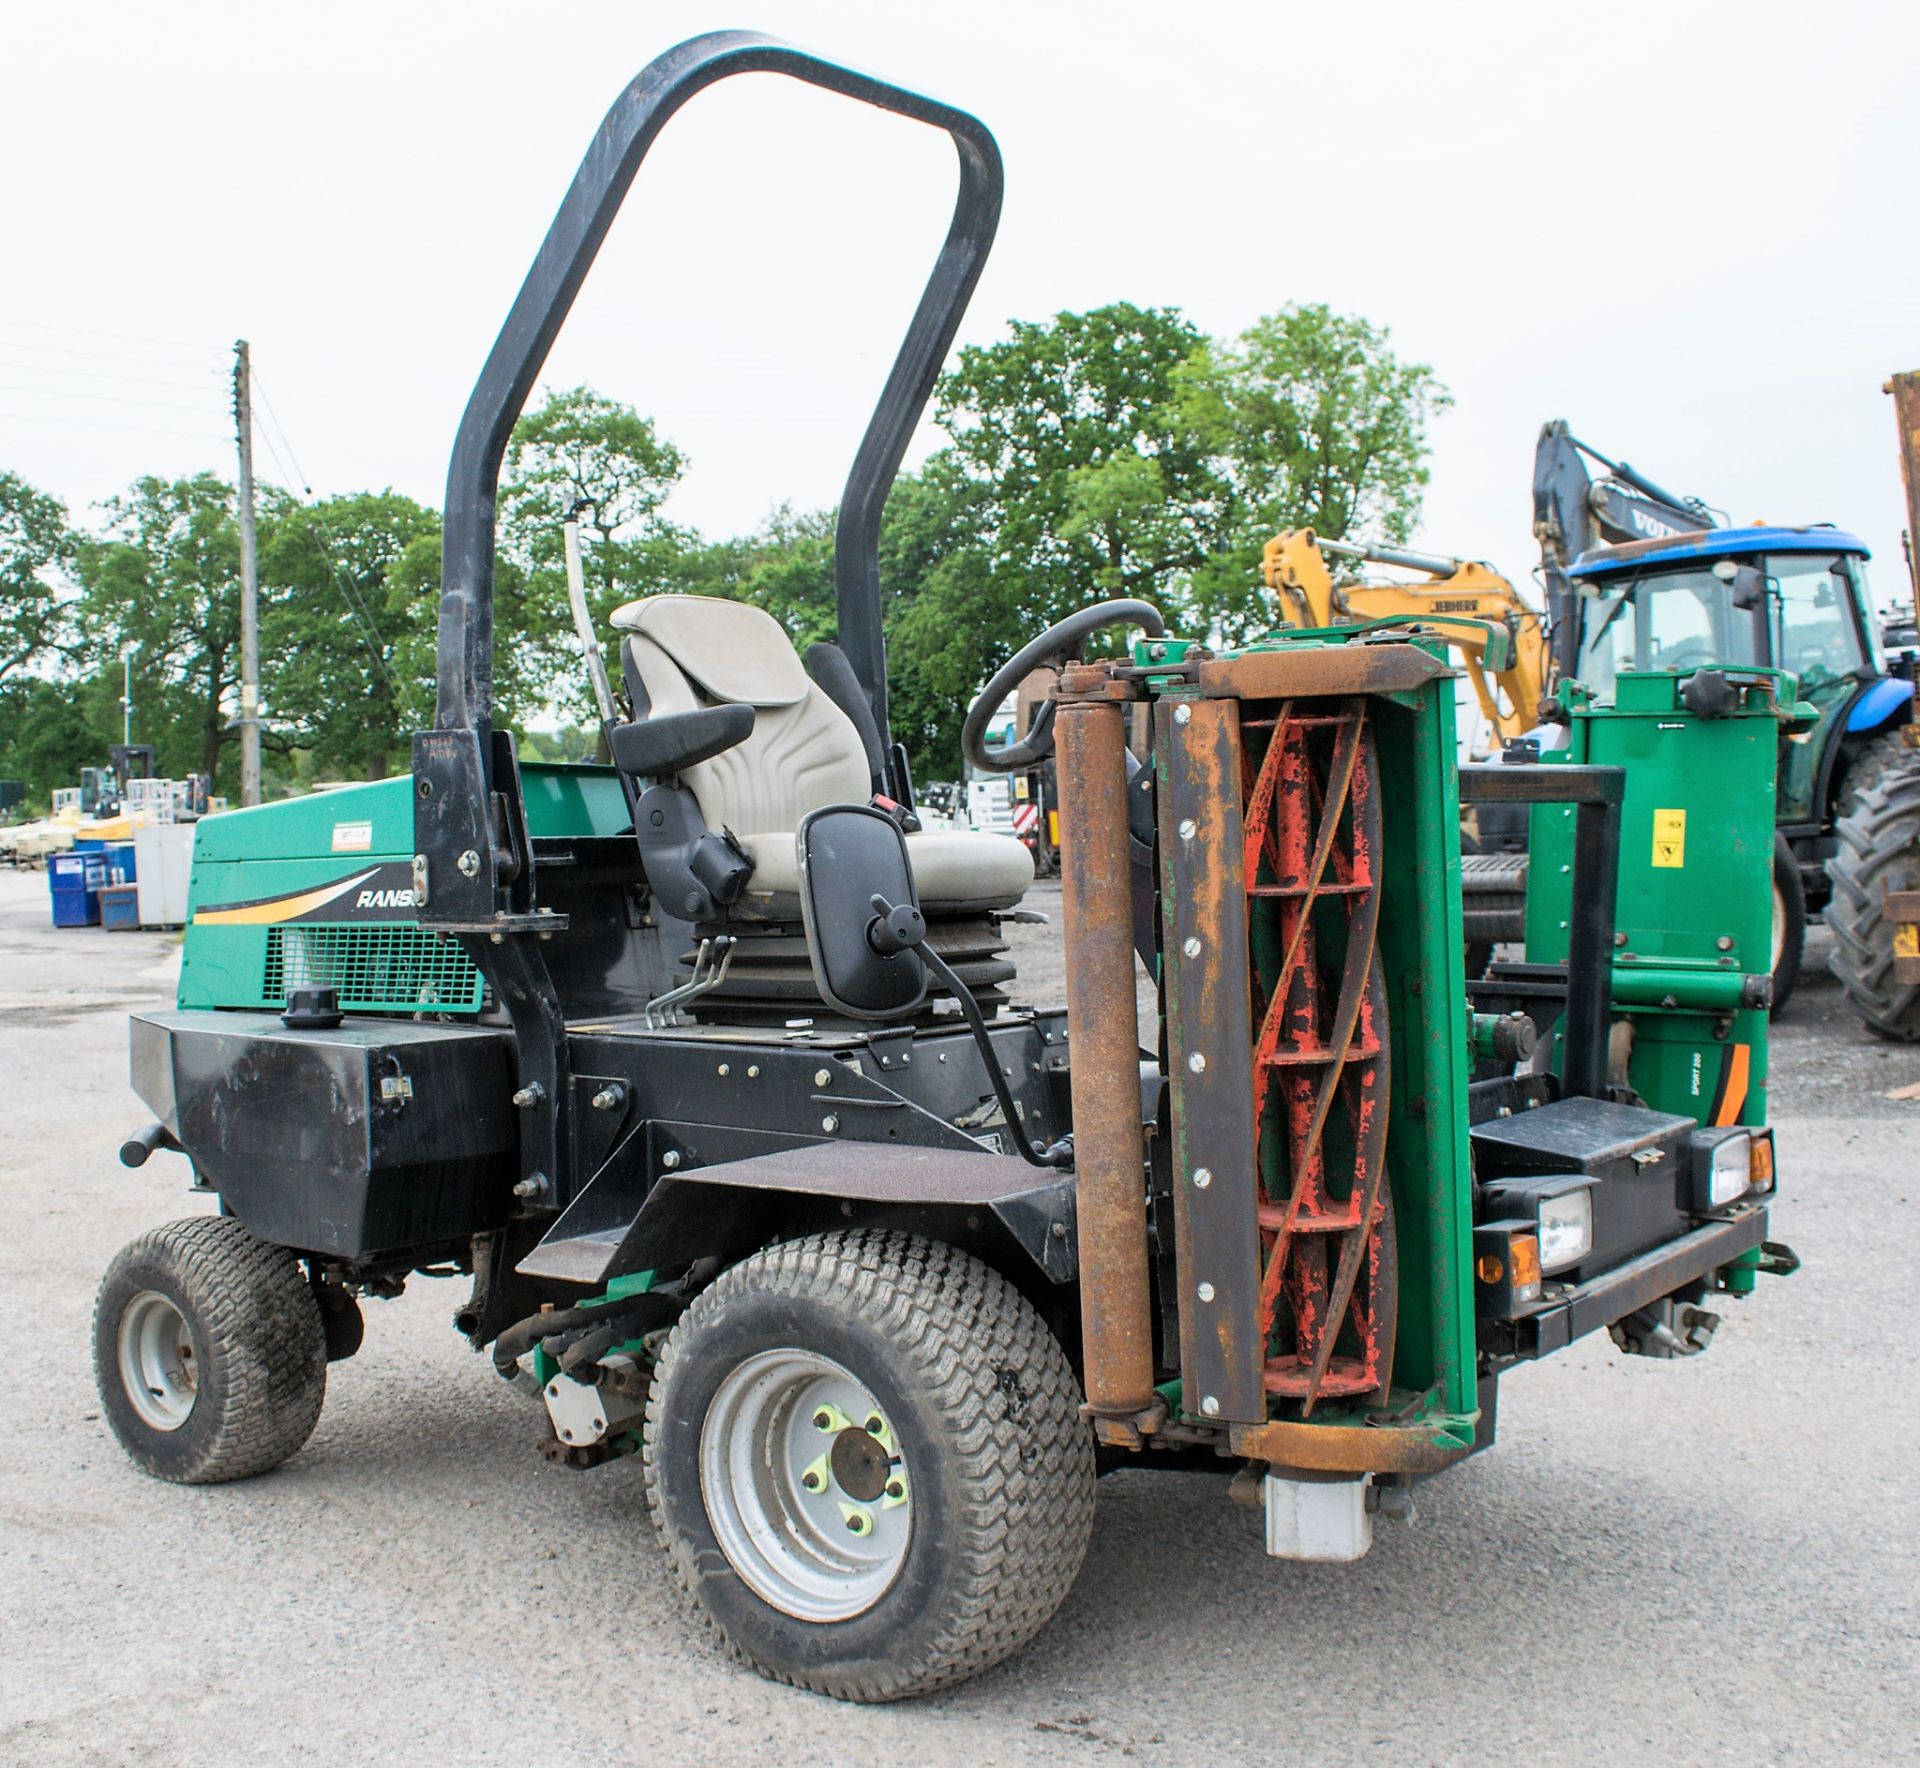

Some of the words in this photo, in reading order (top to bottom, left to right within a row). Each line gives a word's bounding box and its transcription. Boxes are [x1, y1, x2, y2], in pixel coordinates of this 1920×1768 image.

[1632, 509, 1682, 539] VOLV
[356, 889, 416, 908] RANS
[1691, 1068, 1701, 1096] SPORT
